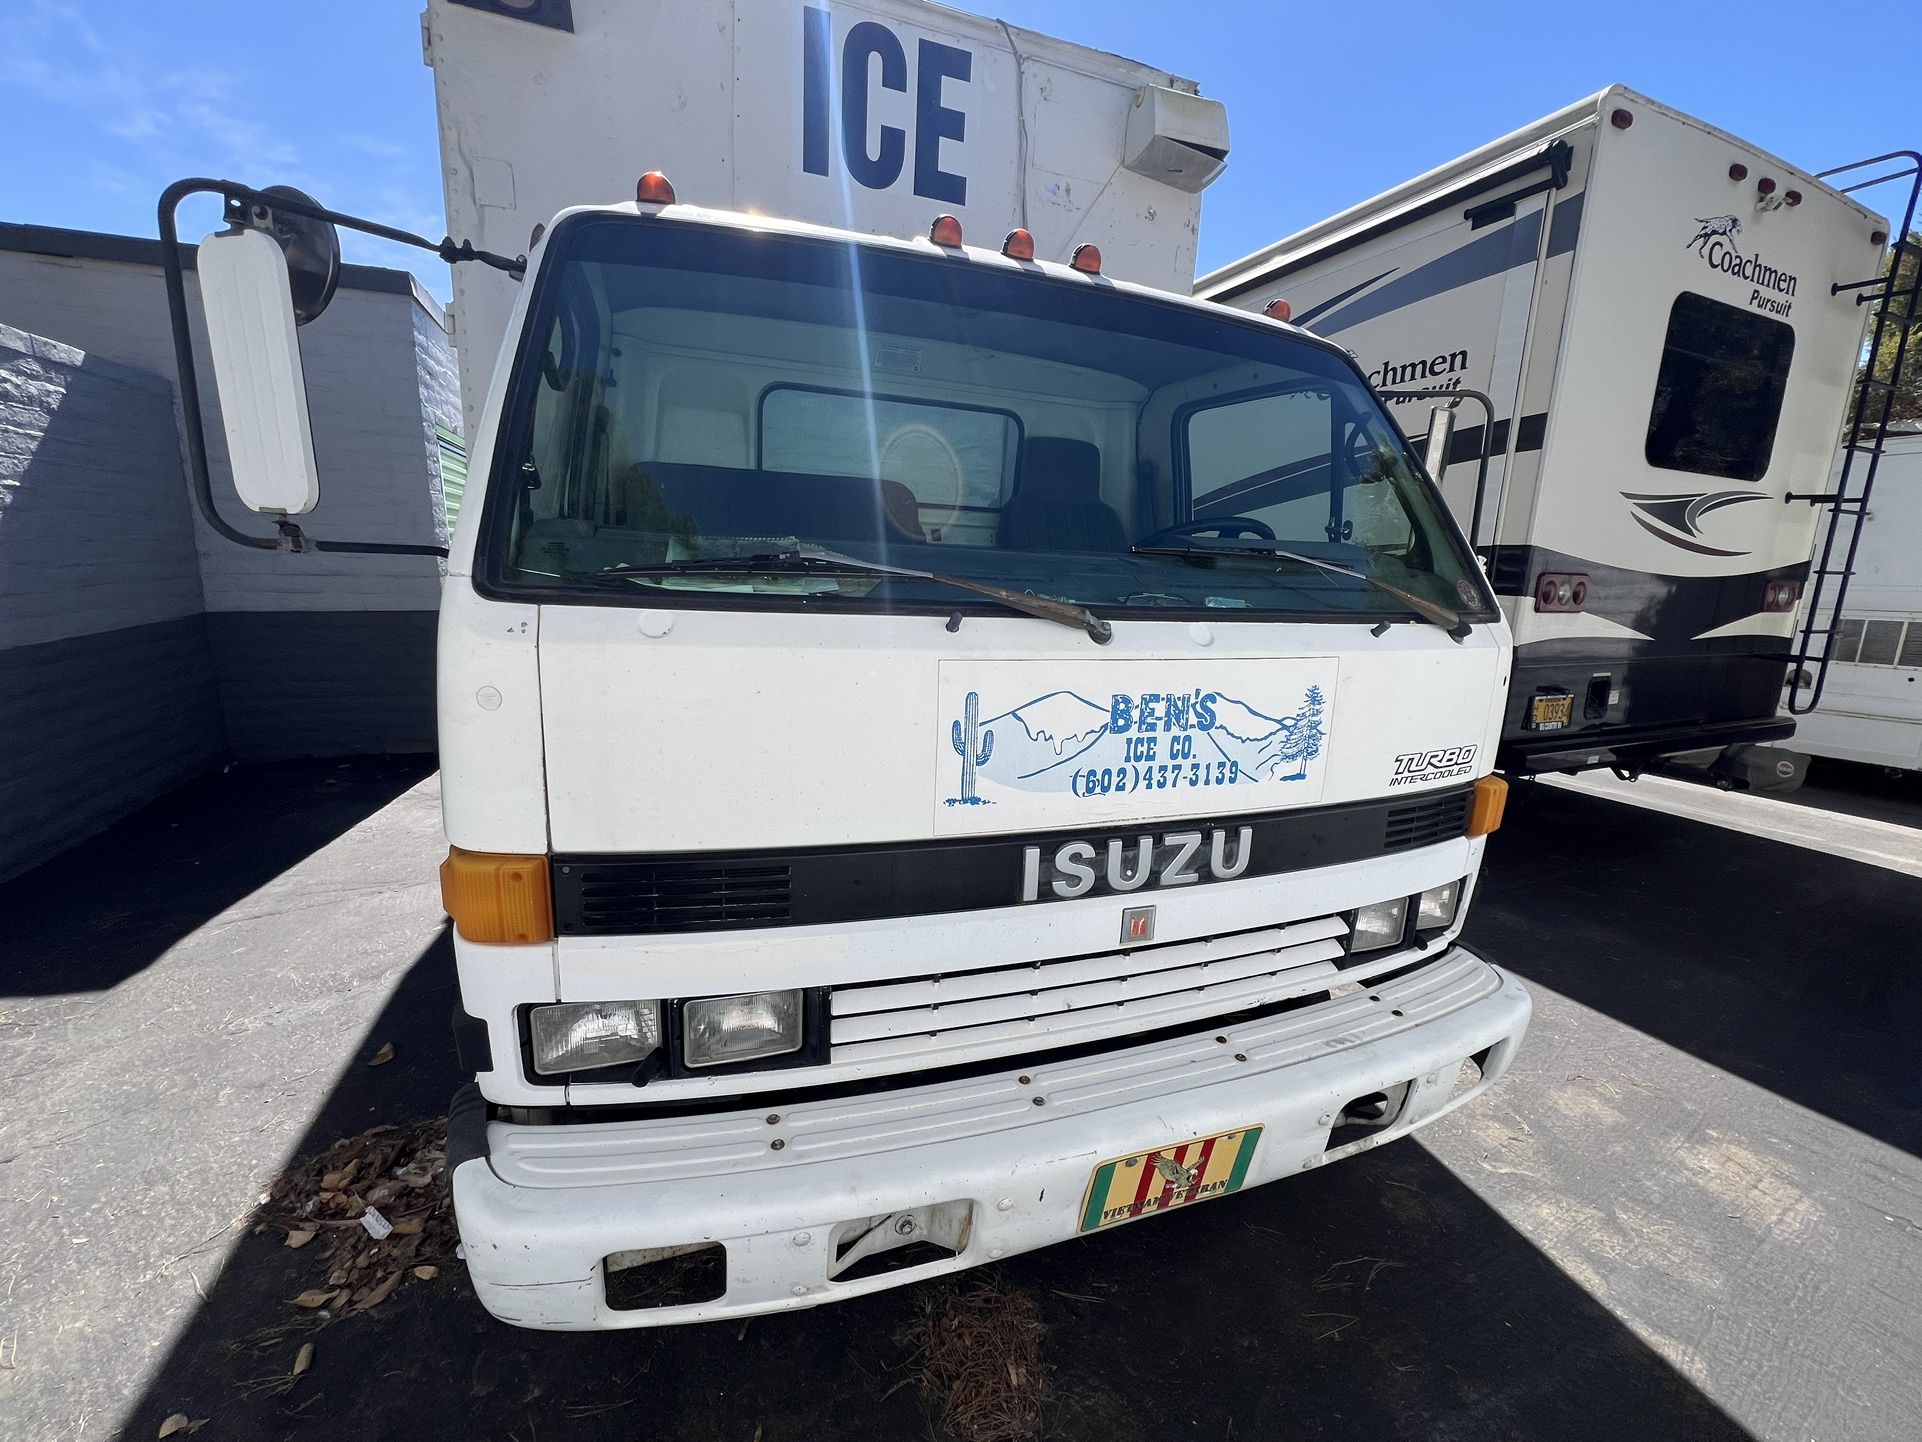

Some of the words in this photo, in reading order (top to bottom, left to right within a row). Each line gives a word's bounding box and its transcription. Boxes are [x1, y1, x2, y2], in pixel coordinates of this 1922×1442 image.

[802, 5, 972, 206] ICE
[1708, 241, 1797, 297] Coachmen
[1748, 289, 1792, 318] Pursuit
[1109, 688, 1218, 734] BEN'S
[1124, 736, 1158, 763] ICE
[1169, 735, 1197, 762] CO.
[1394, 744, 1478, 775] TURBO
[1071, 760, 1239, 798] (602)437-3139
[1388, 765, 1473, 787] INTERCOOLED
[1021, 826, 1253, 901] ISUZU
[1103, 1195, 1165, 1220] VIETNAM
[1167, 1179, 1228, 1203] VETERAN
